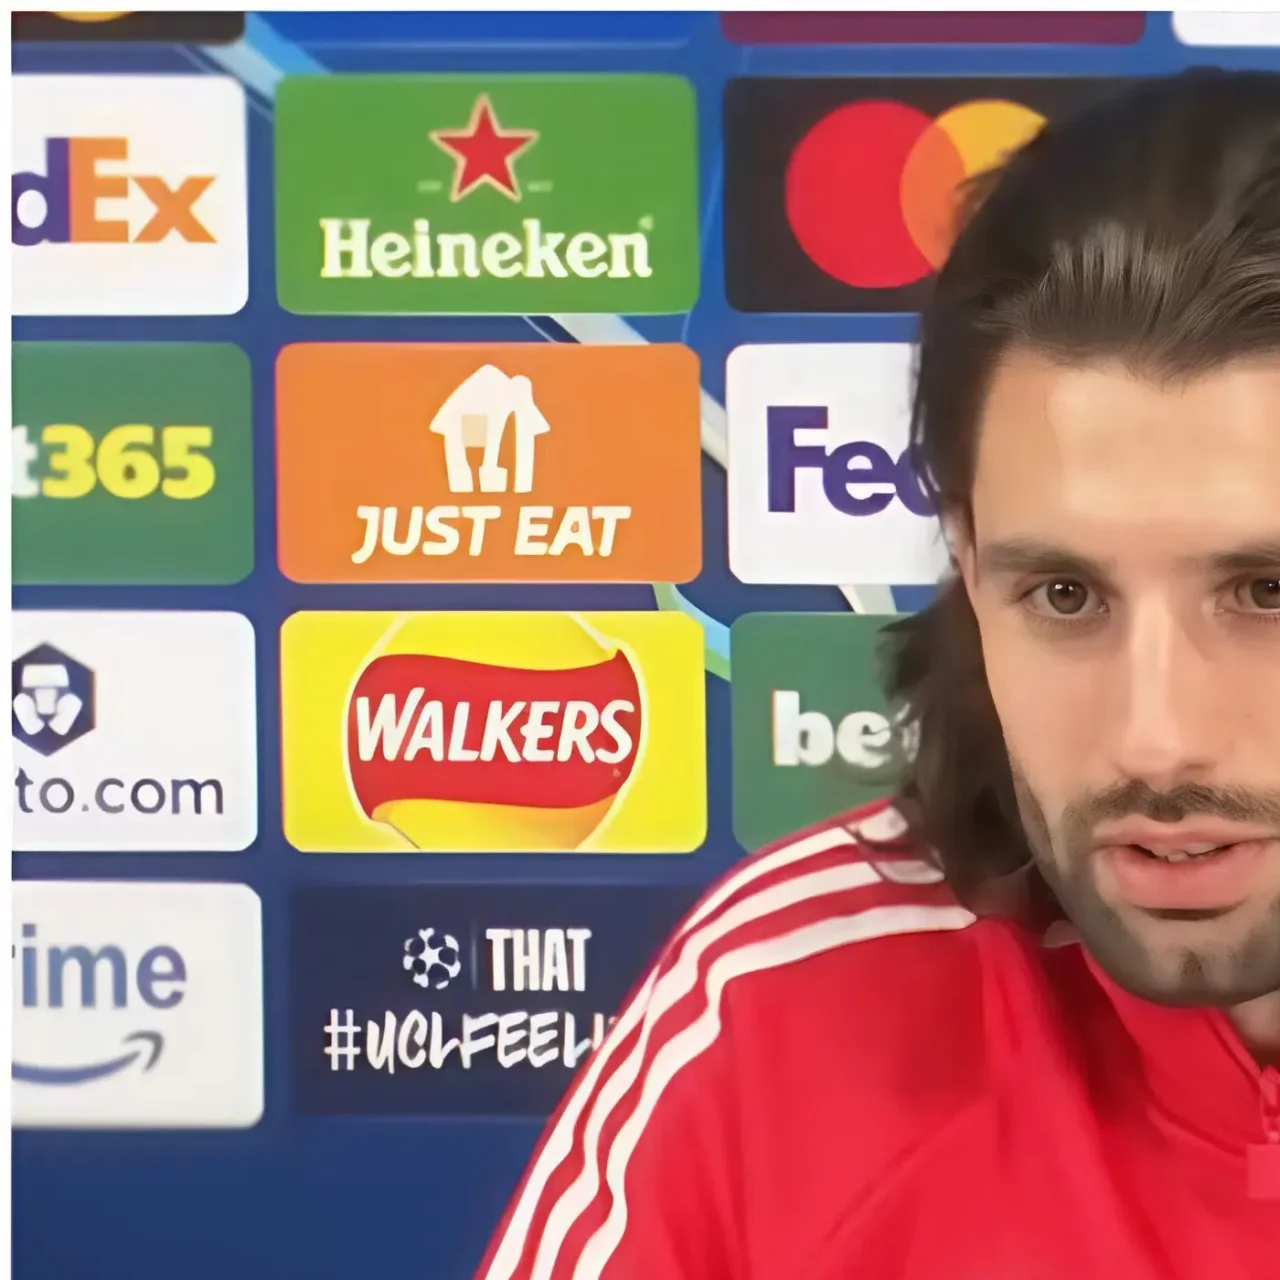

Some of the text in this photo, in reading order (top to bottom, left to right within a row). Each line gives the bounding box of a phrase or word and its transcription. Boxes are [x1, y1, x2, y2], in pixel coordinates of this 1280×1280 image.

[319, 218, 653, 279] Heineken
[351, 506, 632, 564] JUST EAT
[356, 686, 636, 766] WALKERS
[772, 689, 912, 768] be
[12, 924, 187, 1008] ime
[487, 928, 592, 992] THAT
